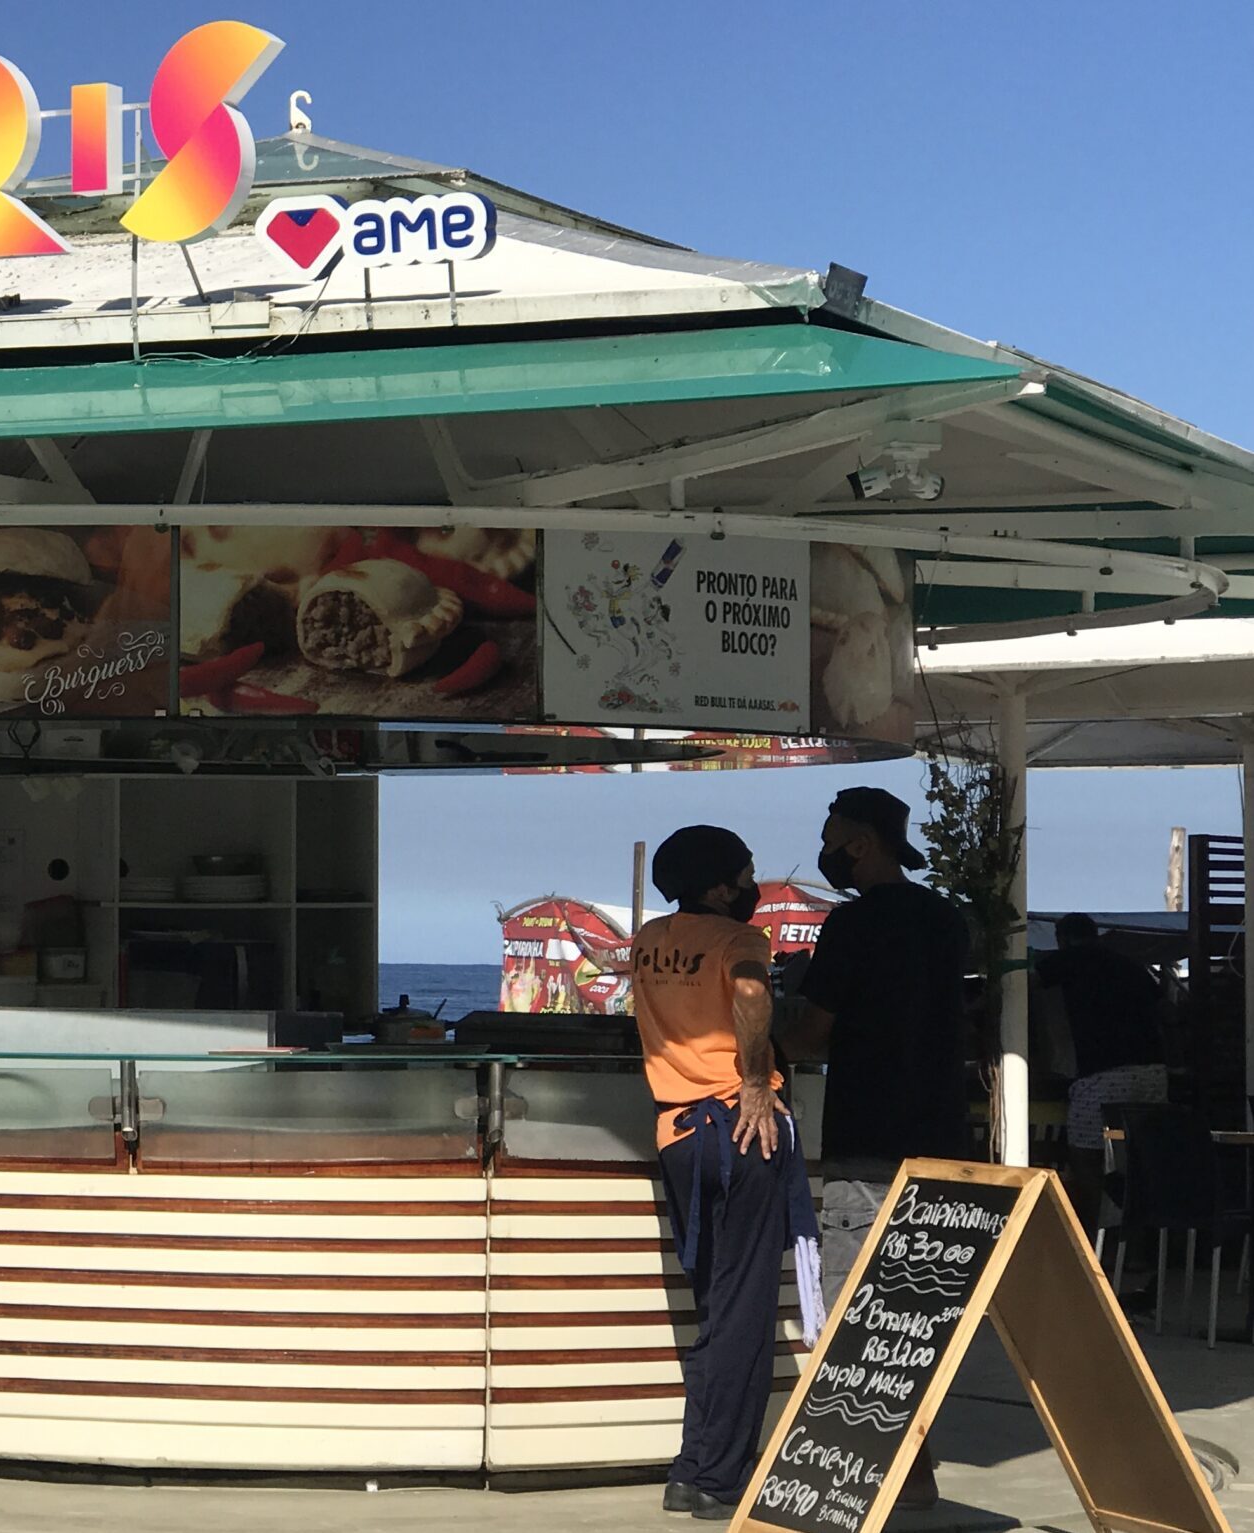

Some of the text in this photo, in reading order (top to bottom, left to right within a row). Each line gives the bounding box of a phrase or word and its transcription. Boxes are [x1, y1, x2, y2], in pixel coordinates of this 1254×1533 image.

[696, 570, 798, 601] PRONTO PARA
[705, 597, 791, 629] O PRÓXIMO
[721, 630, 777, 657] BLOCO?
[25, 645, 165, 704] Burguers
[694, 695, 710, 707] RED
[710, 696, 728, 709] BULL
[728, 697, 737, 709] TE
[779, 923, 823, 942] PETIS
[844, 1283, 875, 1325] 2
